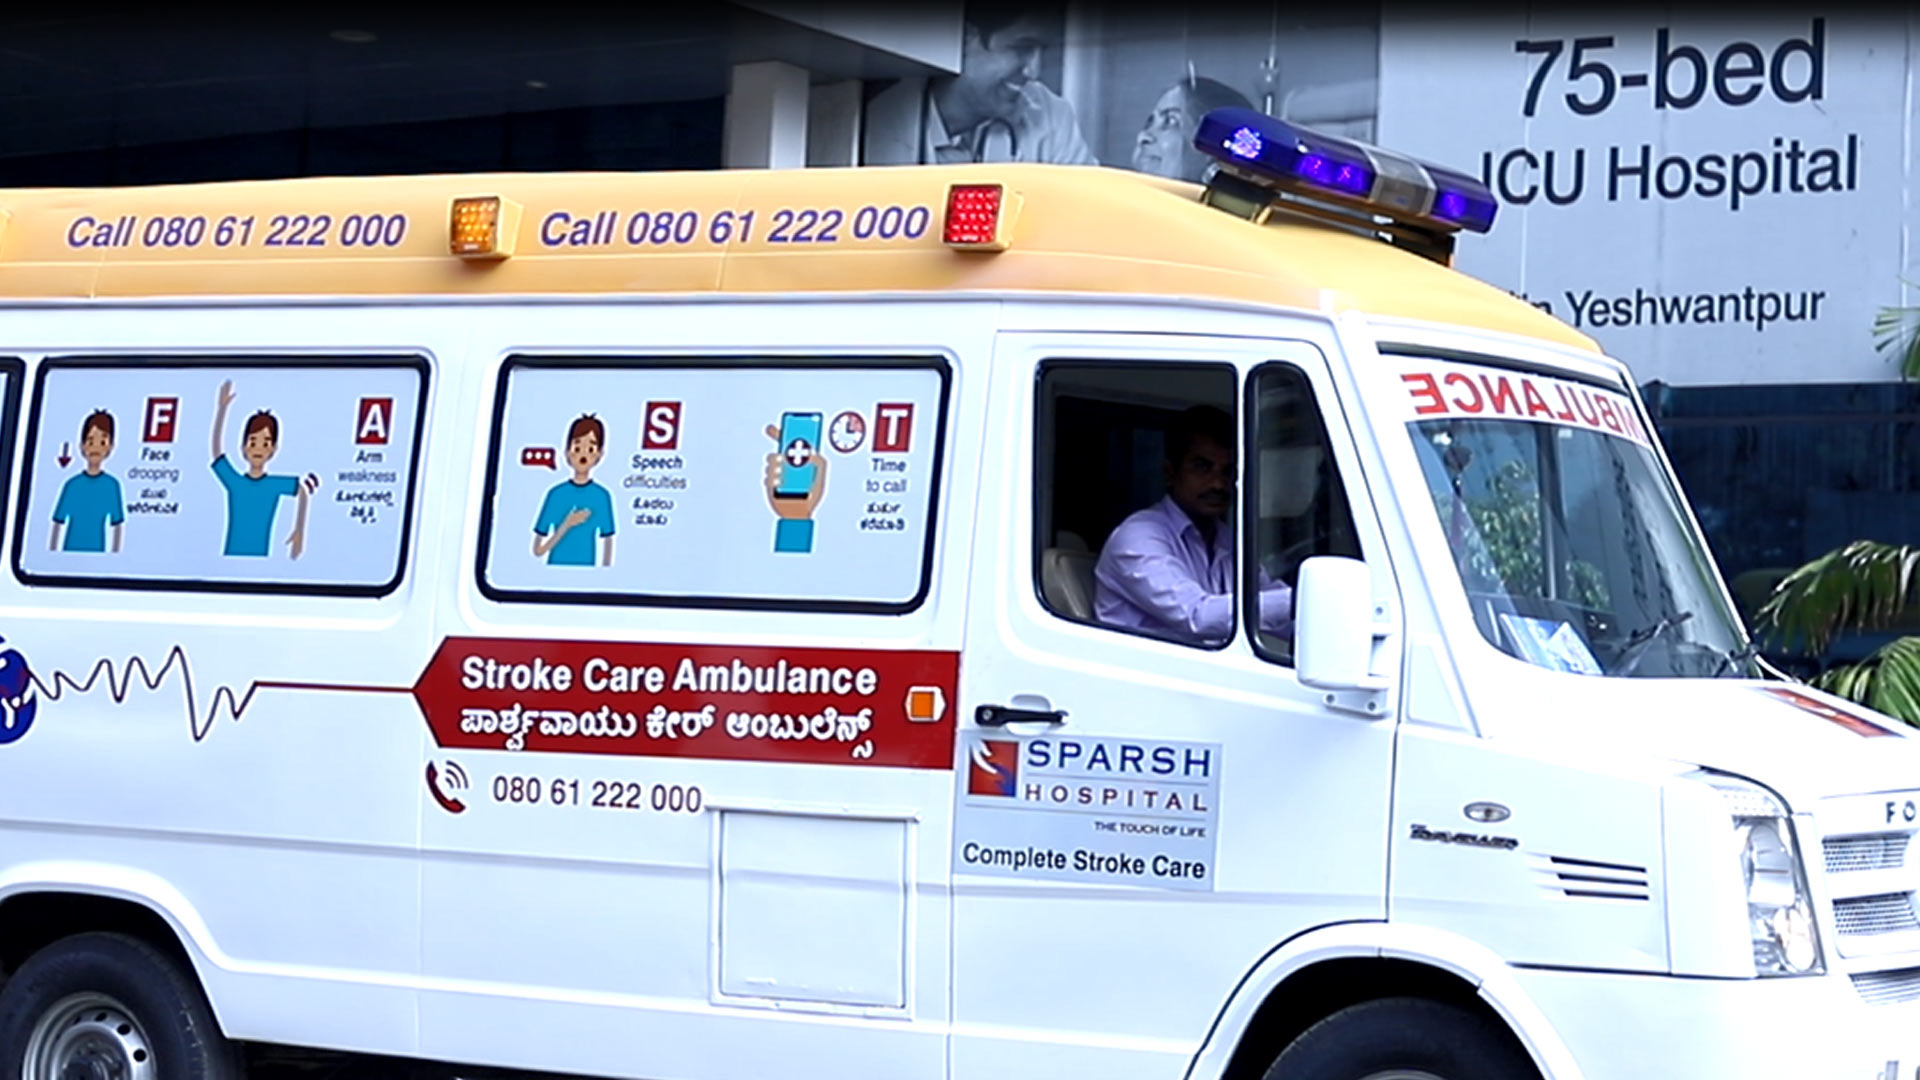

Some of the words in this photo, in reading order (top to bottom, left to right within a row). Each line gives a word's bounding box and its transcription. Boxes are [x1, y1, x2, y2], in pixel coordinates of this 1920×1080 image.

[1514, 16, 1827, 118] 75-bed
[1481, 147, 1586, 206] ICU
[1608, 134, 1857, 211] Hospital
[68, 216, 136, 248] Call
[143, 216, 205, 247] 080
[214, 216, 254, 247] 61
[264, 215, 331, 246] 222
[340, 214, 406, 247] 000
[541, 211, 617, 246] Call
[627, 211, 697, 245] 080
[709, 210, 754, 244] 61
[767, 210, 843, 243] 222
[853, 206, 929, 239] 000
[1566, 287, 1825, 331] Yeshwantpur
[150, 403, 173, 437] F
[359, 403, 385, 438] A
[648, 407, 674, 444] S
[881, 409, 908, 446] T
[141, 447, 170, 461] Face
[356, 450, 383, 463] Arm
[632, 454, 683, 471] Speech
[872, 458, 906, 472] Time
[128, 467, 180, 483] drooping
[338, 469, 396, 483] weakness
[623, 475, 687, 490] difficulties
[866, 479, 880, 493] to
[883, 479, 907, 493] call
[462, 656, 572, 691] Stroke
[584, 658, 665, 693] Care
[672, 658, 877, 695] Ambulance
[646, 705, 716, 739] ಕೇರ್
[726, 706, 873, 758] ಆಂಬುಲೆನ್ಸ್
[1028, 739, 1210, 777] SPARSH
[493, 775, 541, 804] 080
[550, 778, 579, 805] 61
[591, 780, 641, 809] 222
[651, 784, 701, 813] 000
[1025, 784, 1208, 812] HOSPITAL
[1095, 821, 1116, 832] THE
[1120, 822, 1160, 834] TOUCH
[1162, 825, 1177, 835] OF
[1180, 827, 1204, 837] LIFE
[963, 842, 1067, 871] Complete
[1073, 849, 1145, 875] Stroke
[1152, 855, 1206, 879] Care
